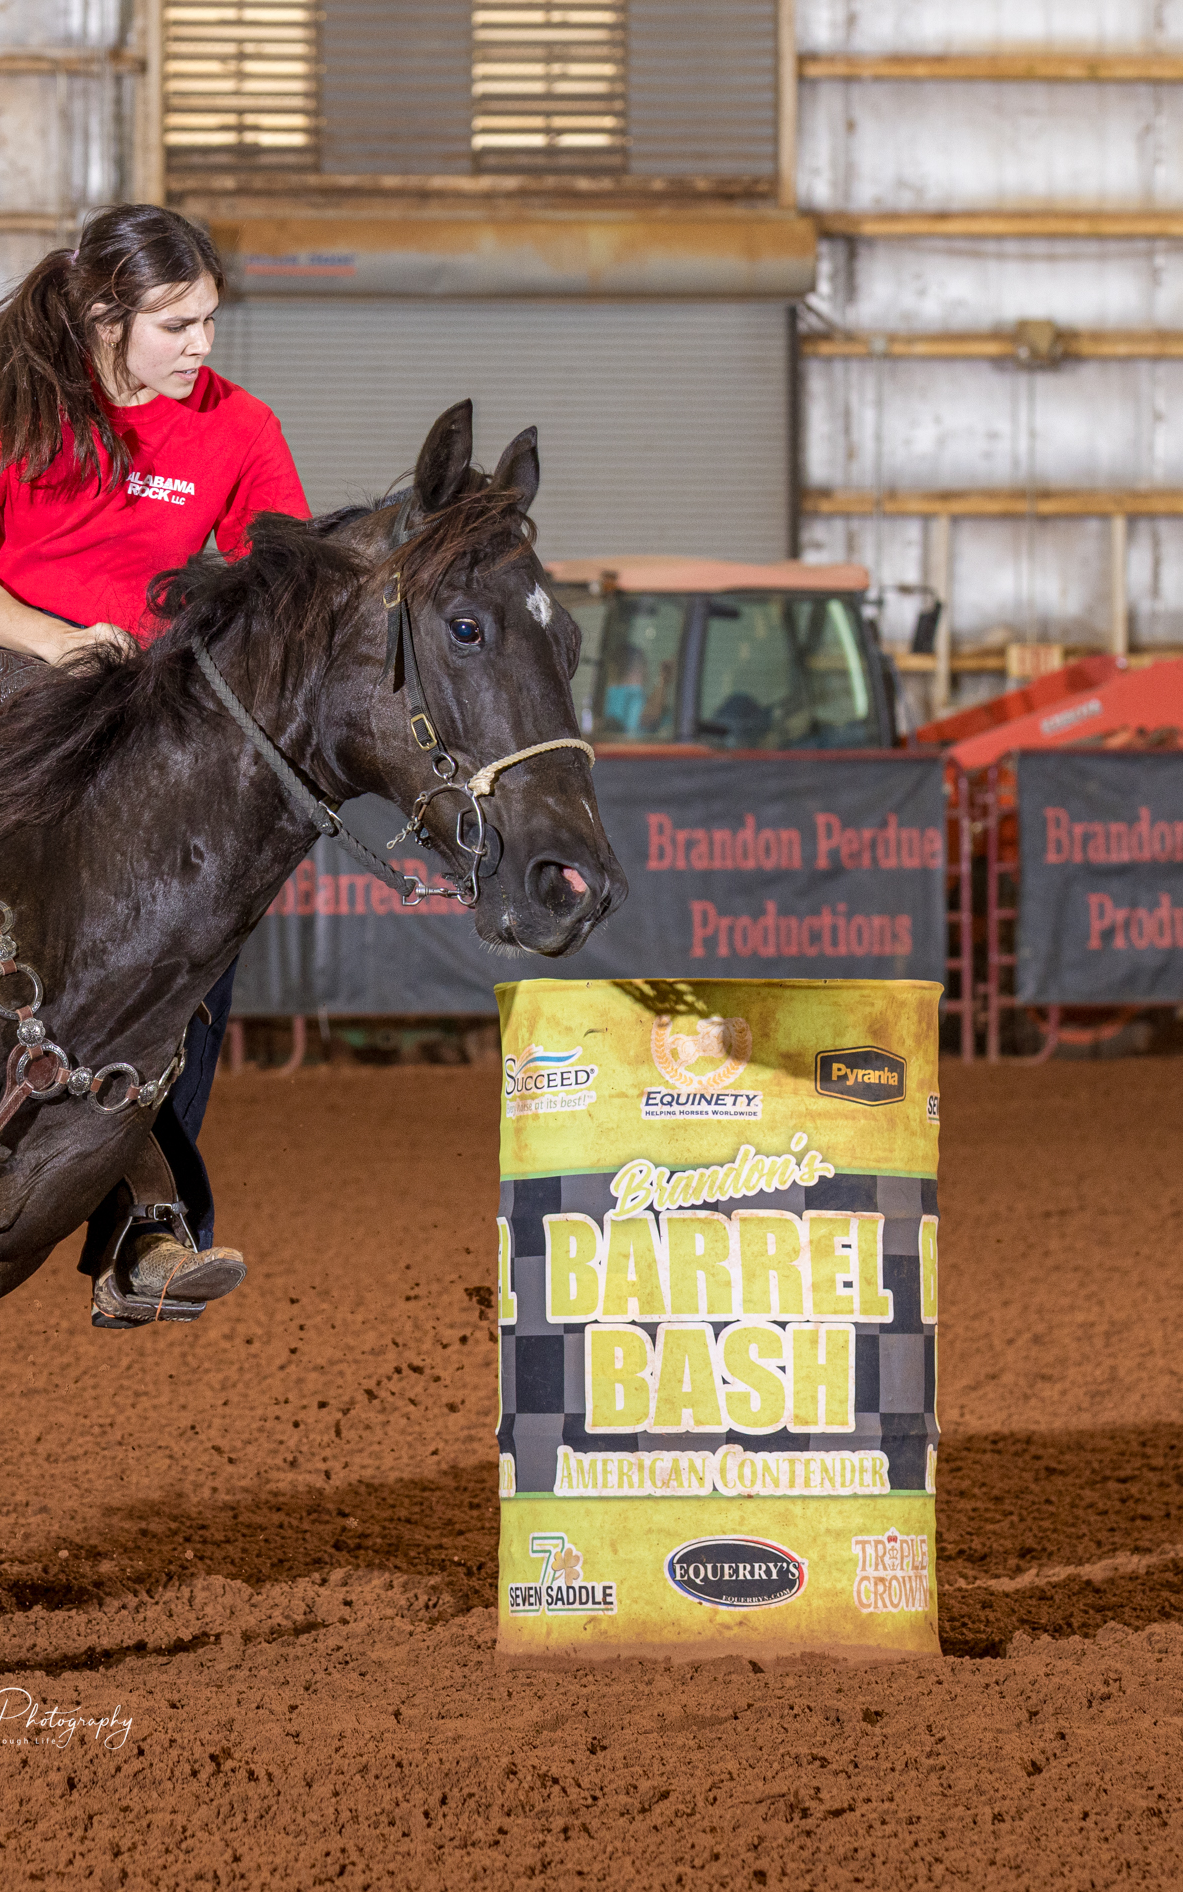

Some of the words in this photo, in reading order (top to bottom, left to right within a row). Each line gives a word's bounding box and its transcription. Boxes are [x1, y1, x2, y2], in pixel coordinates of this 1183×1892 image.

[126, 471, 195, 495] ALABAMA
[127, 483, 170, 502] ROCK
[171, 495, 186, 505] LLC
[646, 813, 802, 871] Brandon
[813, 813, 943, 870] Perdue
[690, 901, 913, 958] Productions
[831, 1063, 899, 1086] Pyranha
[535, 1100, 544, 1109] at
[547, 1097, 557, 1109] its
[645, 1091, 759, 1108] EQUINETY
[712, 1109, 758, 1117] WORLDWIDE
[611, 1133, 834, 1220] Brandon's
[545, 1211, 893, 1322] BARREL
[586, 1322, 854, 1432] BASH
[559, 1451, 707, 1490] AMERICAN
[719, 1450, 887, 1490] CONTENDER
[673, 1561, 799, 1585] EQUERRY'S
[509, 1586, 542, 1607] SEVEN
[545, 1585, 613, 1606] SADDLE
[722, 1588, 791, 1604] EQUERRYS.COM
[856, 1575, 927, 1609] CROWN
